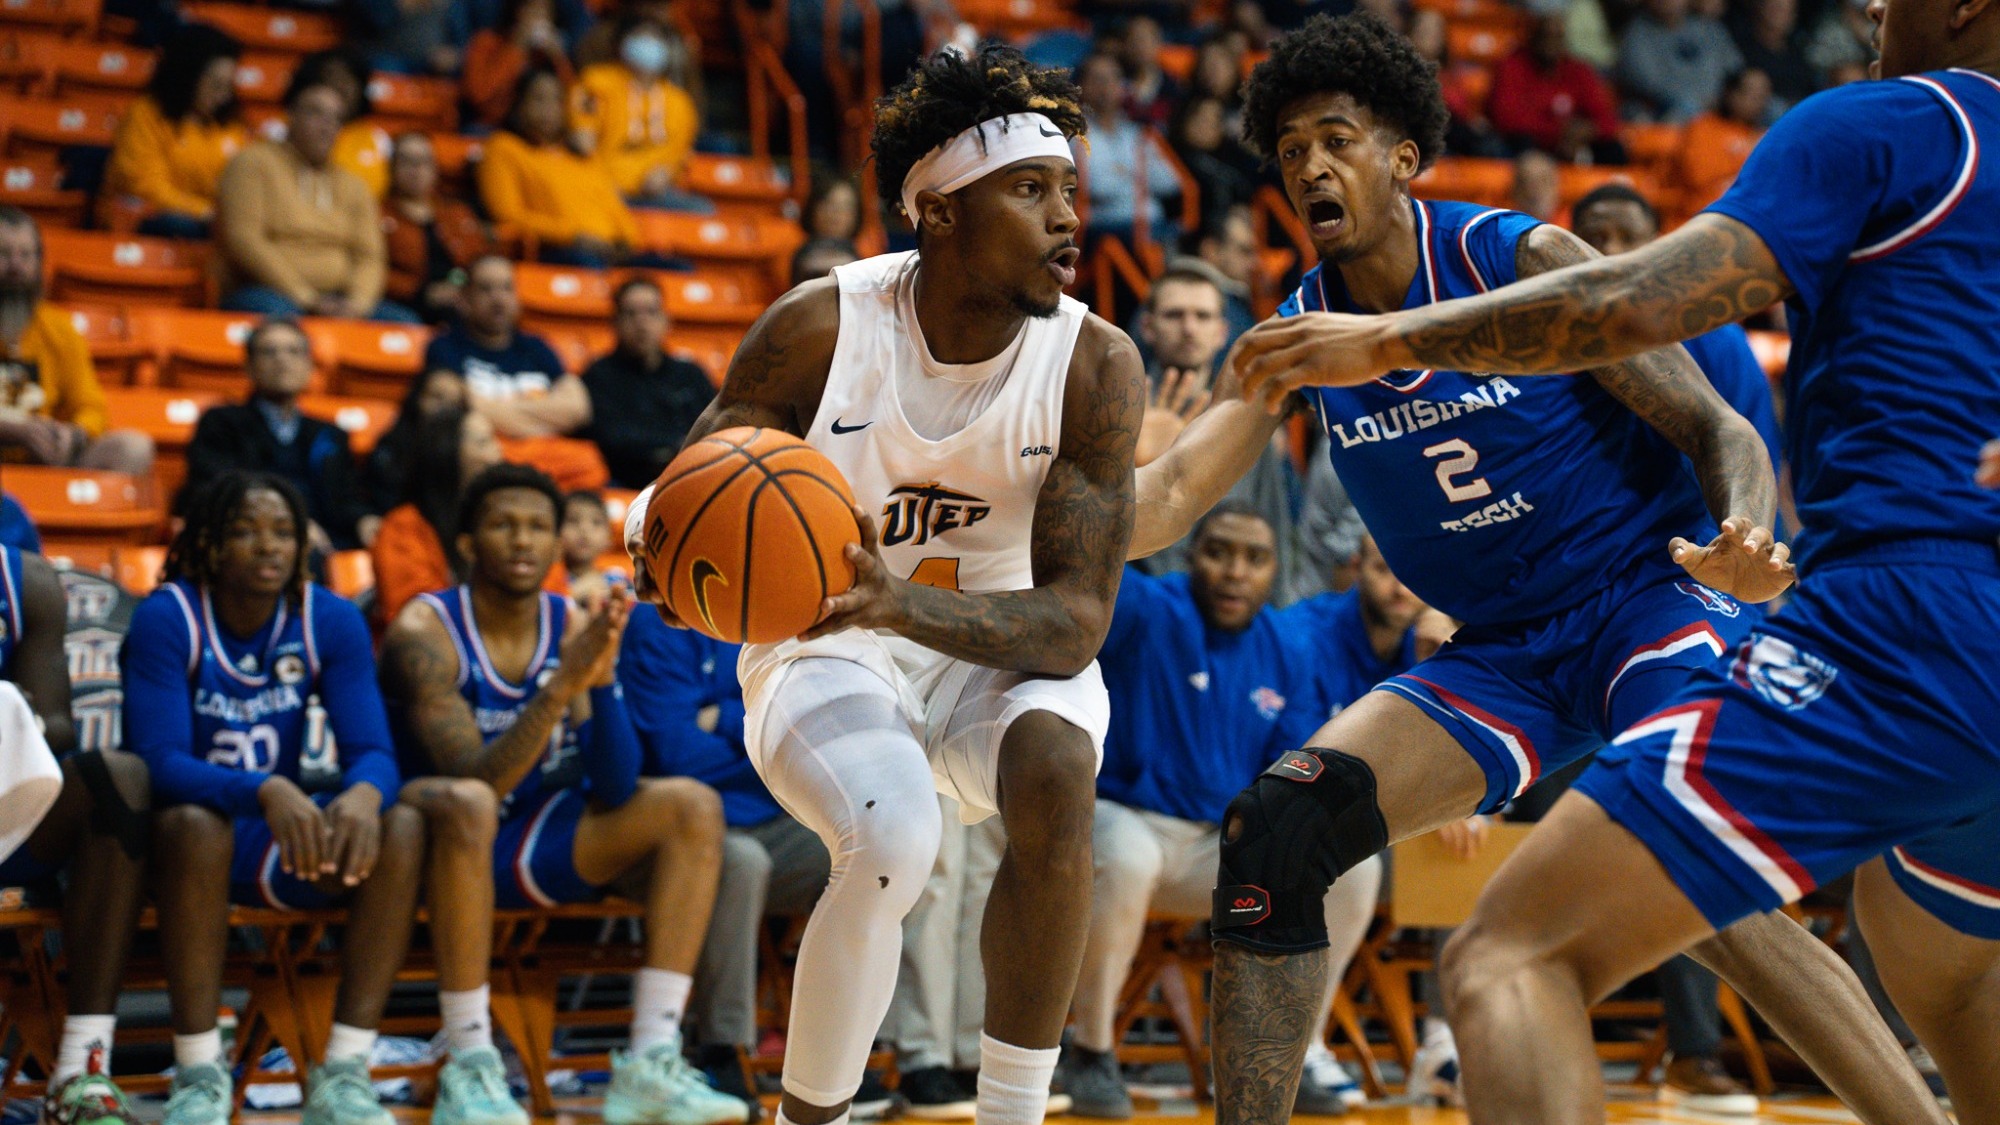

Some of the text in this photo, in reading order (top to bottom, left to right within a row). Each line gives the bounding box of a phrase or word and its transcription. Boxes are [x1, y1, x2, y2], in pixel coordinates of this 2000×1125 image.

[1332, 376, 1521, 449] LOUISIANA
[1422, 437, 1493, 503] 2
[879, 480, 992, 547] UTEP
[1440, 491, 1534, 532] TECH
